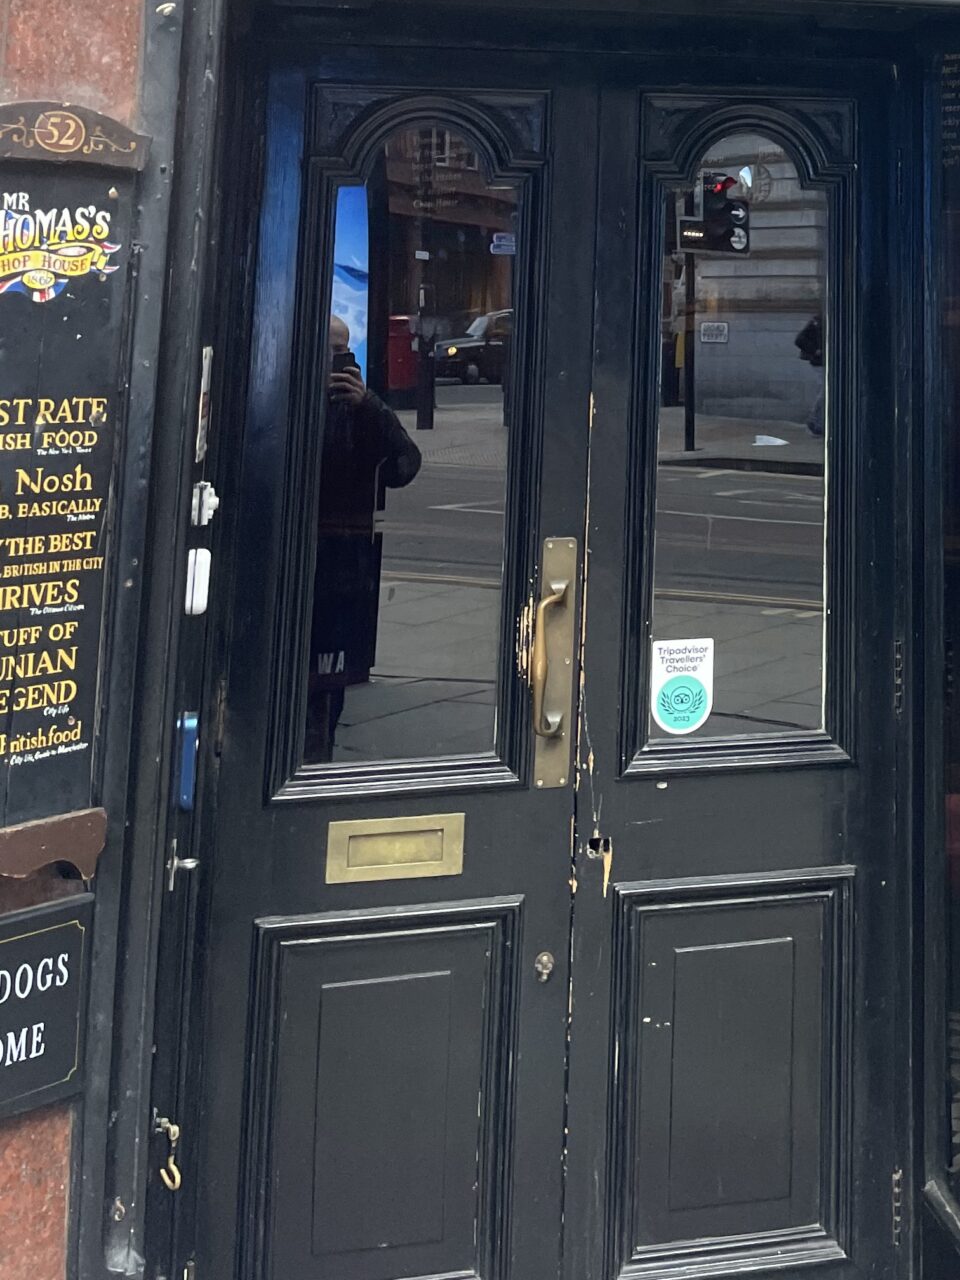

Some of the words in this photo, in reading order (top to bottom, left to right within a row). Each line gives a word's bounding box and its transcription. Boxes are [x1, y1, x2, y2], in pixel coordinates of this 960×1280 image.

[45, 117, 76, 145] 52
[2, 192, 30, 212] MR
[42, 253, 88, 272] HOUSE
[35, 397, 108, 425] RATE
[42, 430, 98, 448] FOOD
[15, 464, 93, 495] Nosh
[18, 498, 103, 518] BASICALLY
[5, 536, 45, 556] THE
[48, 531, 96, 553] BEST
[3, 562, 47, 578] BRITISH
[49, 560, 61, 573] IN
[62, 559, 82, 571] THE
[83, 557, 104, 570] CITY
[49, 622, 78, 641] OF
[658, 646, 708, 656] Tripadvisor
[660, 654, 706, 664] Travellers'
[666, 665, 698, 673] Choice
[49, 720, 82, 748] food
